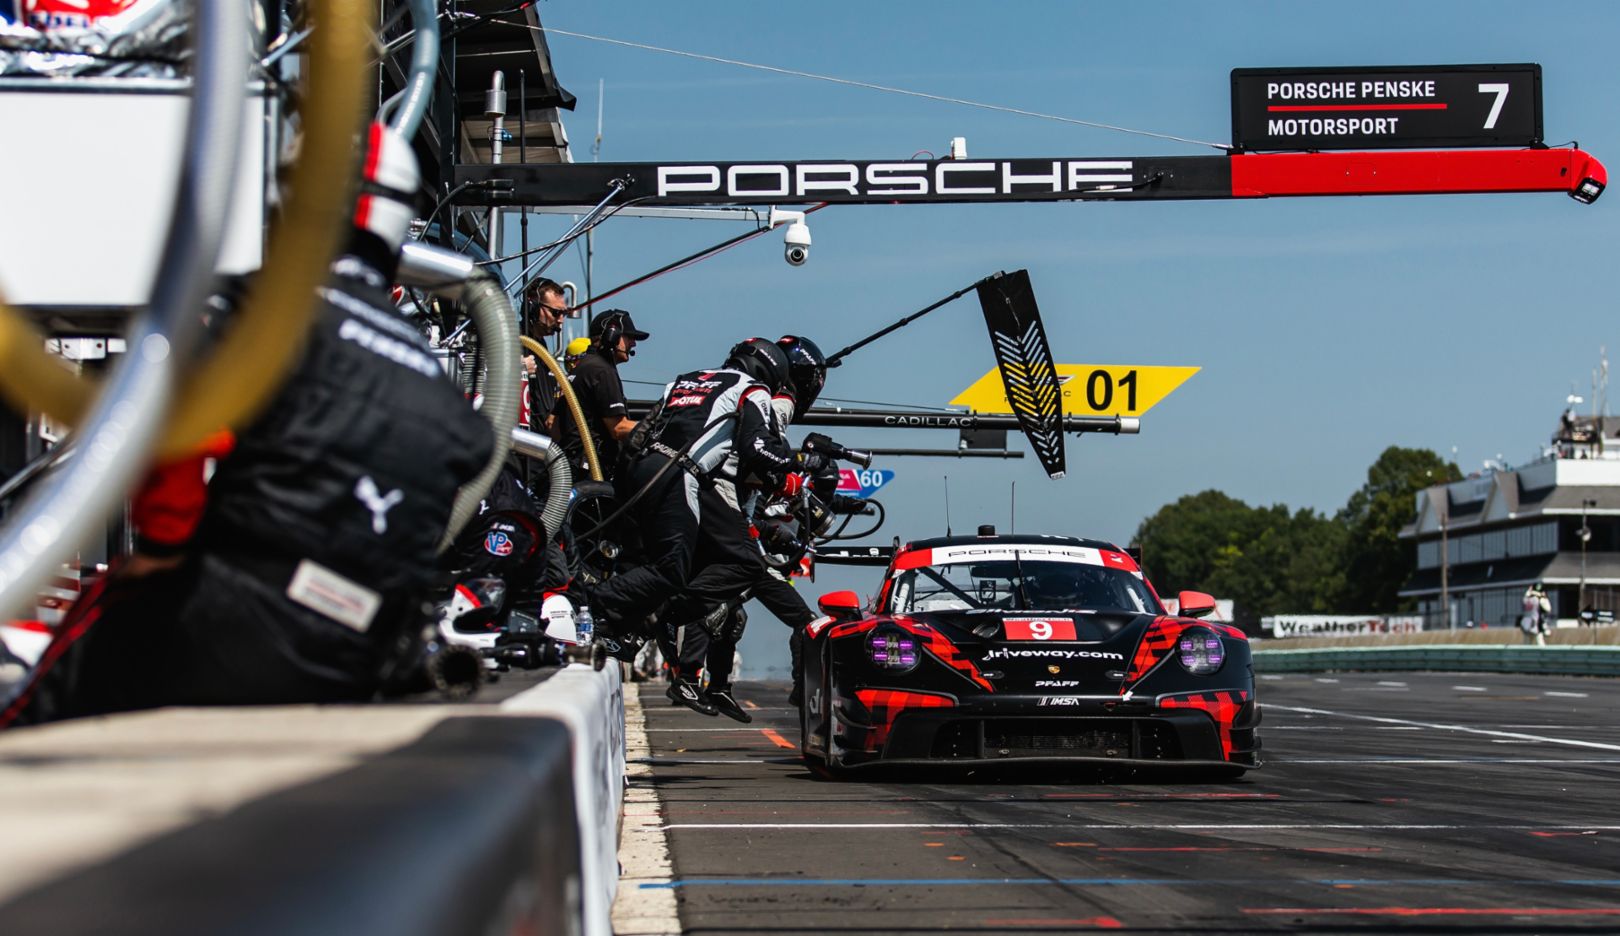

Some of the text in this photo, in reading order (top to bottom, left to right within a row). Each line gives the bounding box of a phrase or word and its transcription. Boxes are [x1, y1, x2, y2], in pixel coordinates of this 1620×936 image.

[1267, 80, 1436, 99] PORSCHE PENSKE
[1478, 83, 1509, 129] 7
[1267, 117, 1399, 136] MOTORSPORT
[657, 161, 1133, 197] PORSCHE
[1086, 369, 1138, 411] 01
[884, 414, 973, 428] CADILLAC
[860, 470, 883, 488] 60
[948, 549, 1086, 558] PORSCHE
[1028, 621, 1053, 640] 9
[1050, 697, 1080, 706] IMSA
